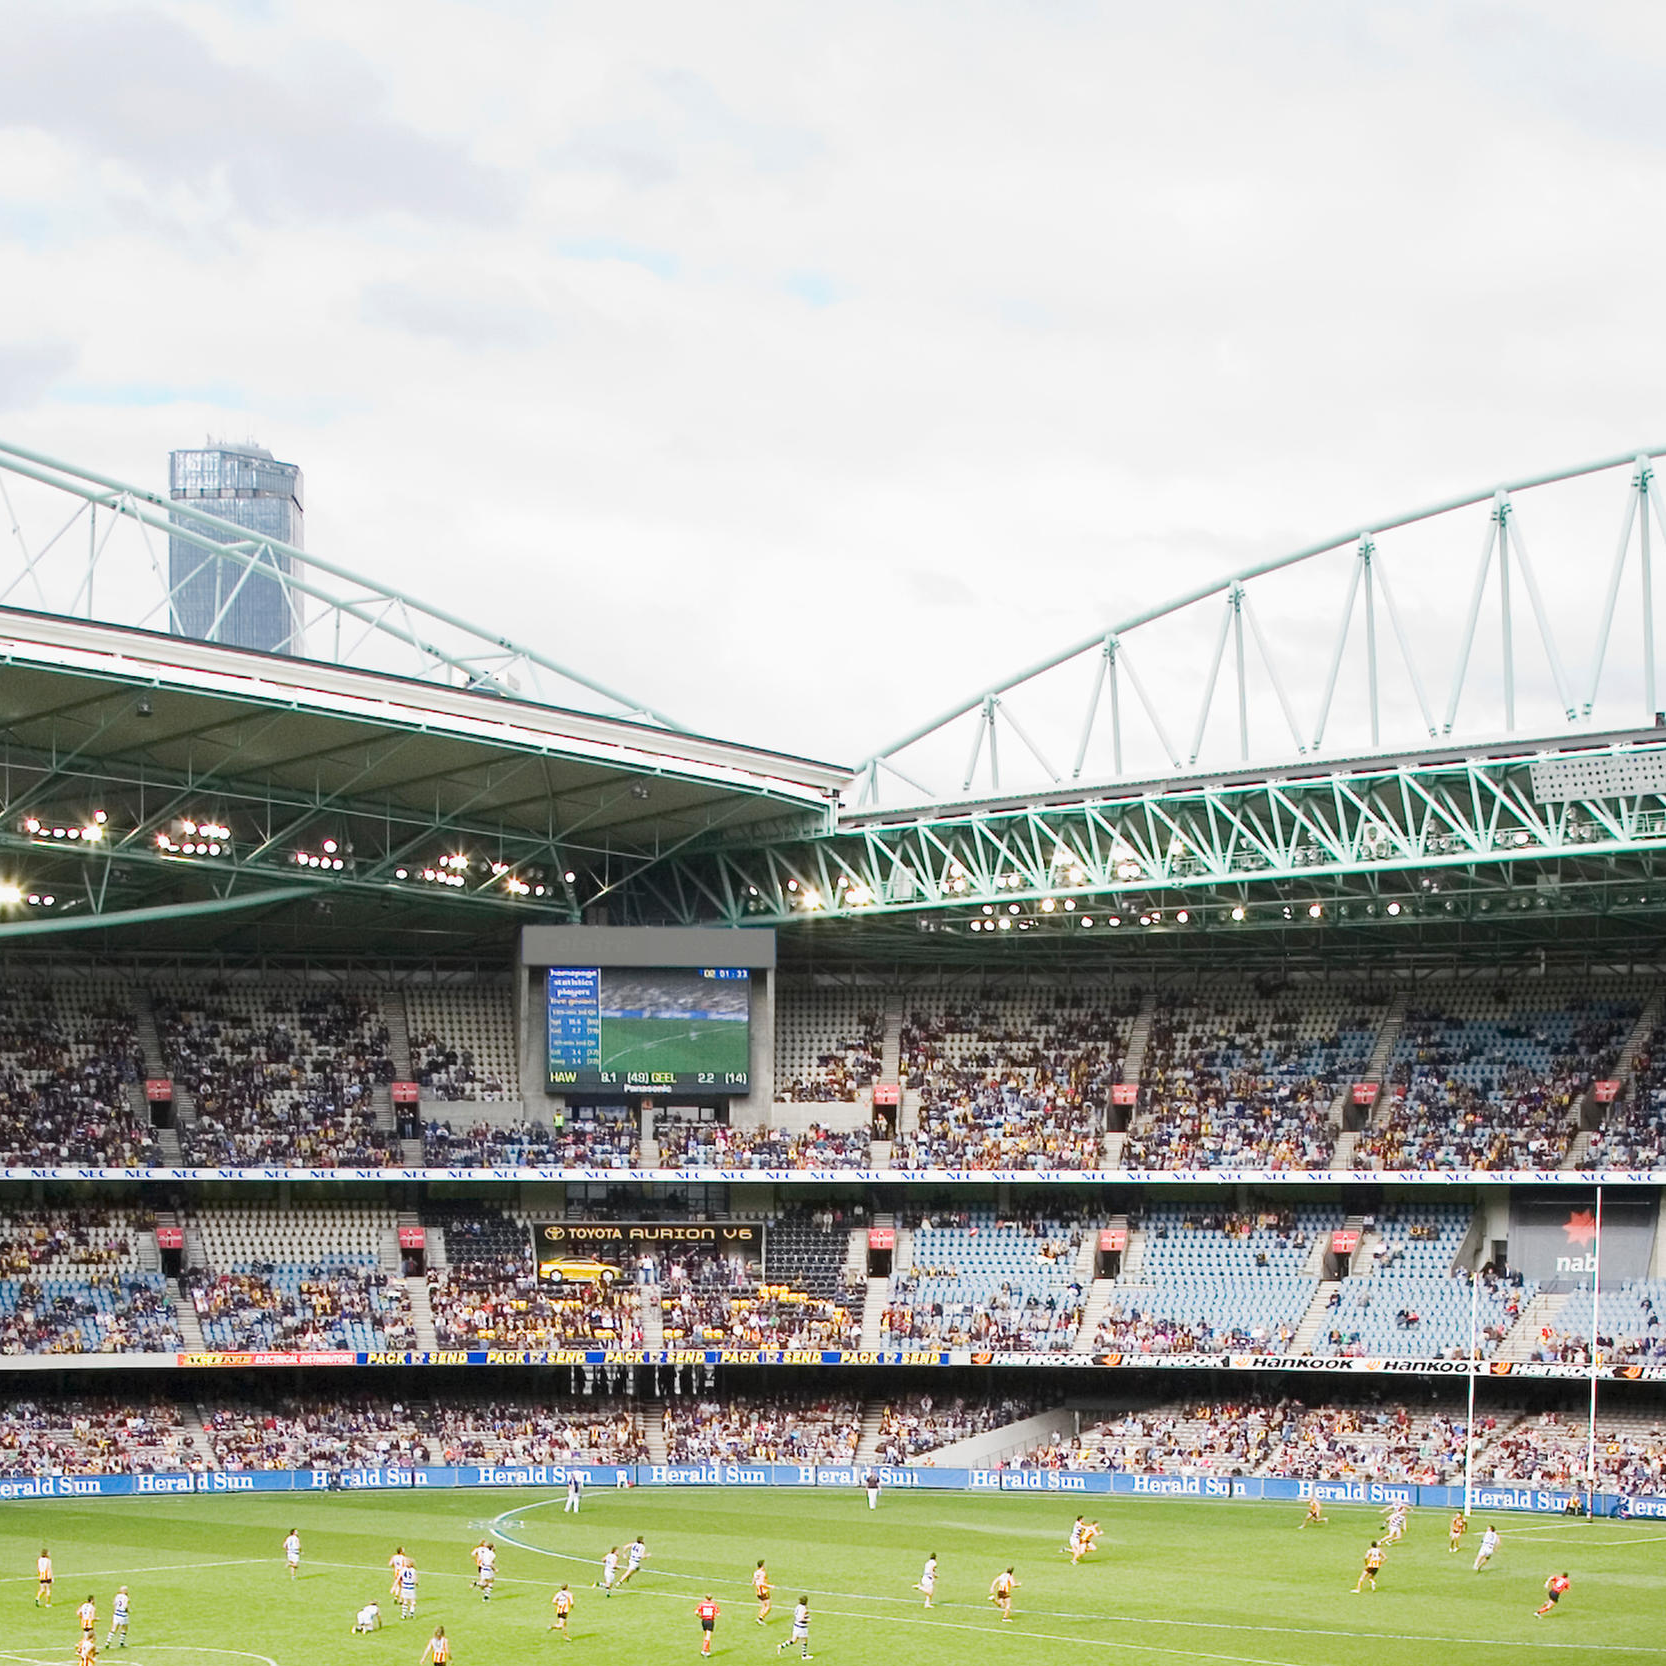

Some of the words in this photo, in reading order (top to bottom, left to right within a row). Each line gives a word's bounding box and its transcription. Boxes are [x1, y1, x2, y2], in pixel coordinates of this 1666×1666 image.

[550, 1072, 577, 1083] HAW
[627, 1072, 650, 1083] (49)
[651, 1072, 677, 1083] GEEL
[725, 1072, 747, 1083] (14)
[623, 1084, 672, 1094] Panasonic
[30, 1169, 62, 1179] NEC
[217, 1169, 245, 1179] NEC
[401, 1170, 431, 1179] NEC
[568, 1228, 623, 1240] TOYOTA
[629, 1228, 715, 1240] AURION
[723, 1228, 753, 1240] V6
[1556, 1253, 1598, 1272] nab
[367, 1352, 407, 1364] PACK
[428, 1352, 468, 1364] SEND
[486, 1352, 526, 1364] PACK
[546, 1352, 586, 1364] SEND
[604, 1352, 644, 1364] PACK
[667, 1352, 706, 1364] SEND
[720, 1352, 759, 1364] PACK
[782, 1352, 822, 1364] SEND
[839, 1352, 879, 1364] PACK
[900, 1352, 941, 1364] SEND
[137, 1472, 210, 1493] Herald
[214, 1472, 254, 1490] Sun
[311, 1468, 381, 1488] Hrald
[386, 1466, 428, 1485] Sun
[477, 1466, 552, 1484] Herald
[650, 1466, 724, 1484] Herald
[726, 1466, 766, 1483] Sun
[879, 1467, 919, 1485] Sun
[972, 1469, 1045, 1488] Herald
[1047, 1471, 1086, 1489] Sun
[59, 1476, 102, 1495] Sun
[1132, 1475, 1201, 1494] Herald
[1205, 1477, 1246, 1496] Sun
[1297, 1480, 1366, 1499] Herald
[1370, 1484, 1410, 1502] Sun
[1470, 1488, 1534, 1508] Herald
